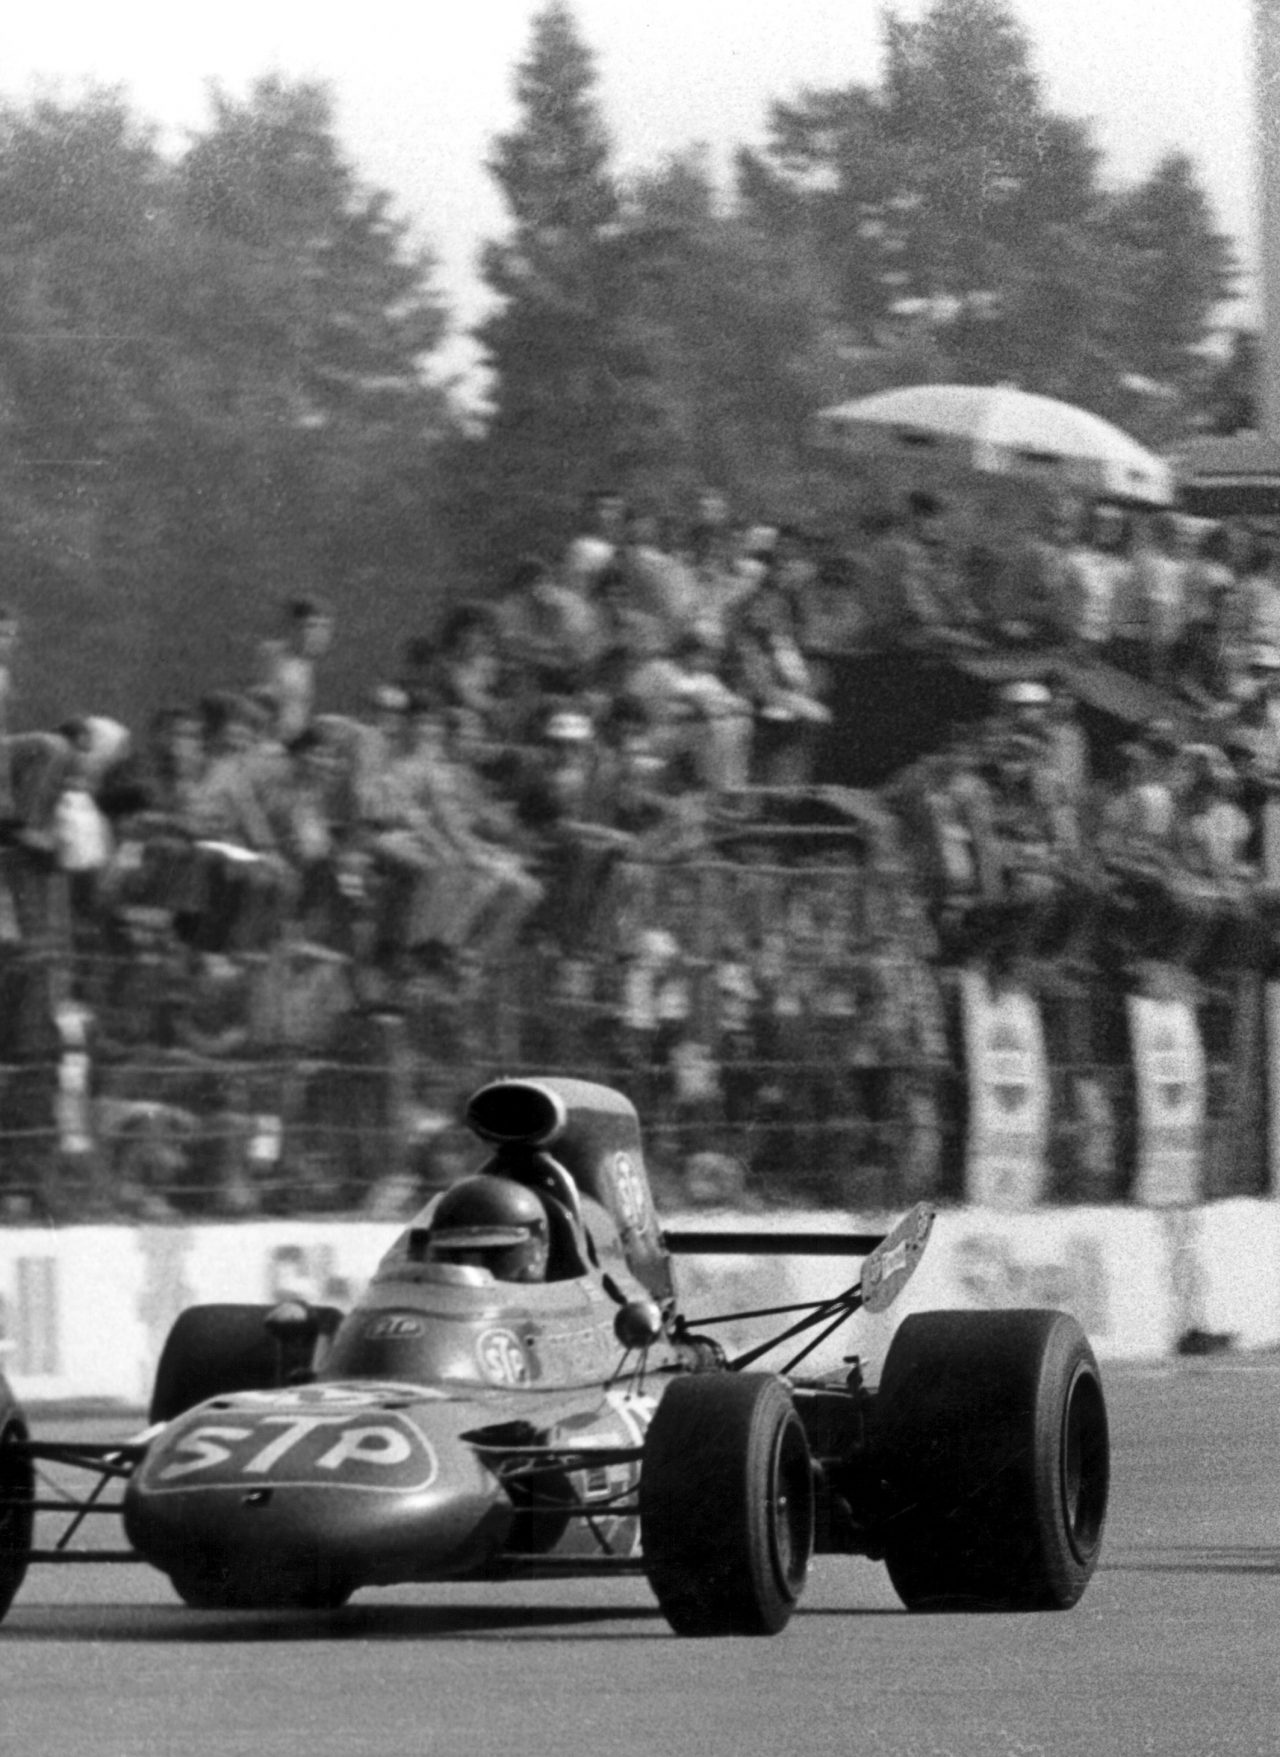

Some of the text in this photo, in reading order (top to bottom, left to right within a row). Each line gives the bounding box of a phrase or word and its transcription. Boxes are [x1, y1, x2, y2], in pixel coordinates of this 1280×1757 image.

[374, 1316, 420, 1334] STP
[486, 1337, 527, 1383] STP
[159, 1415, 411, 1480] STP
